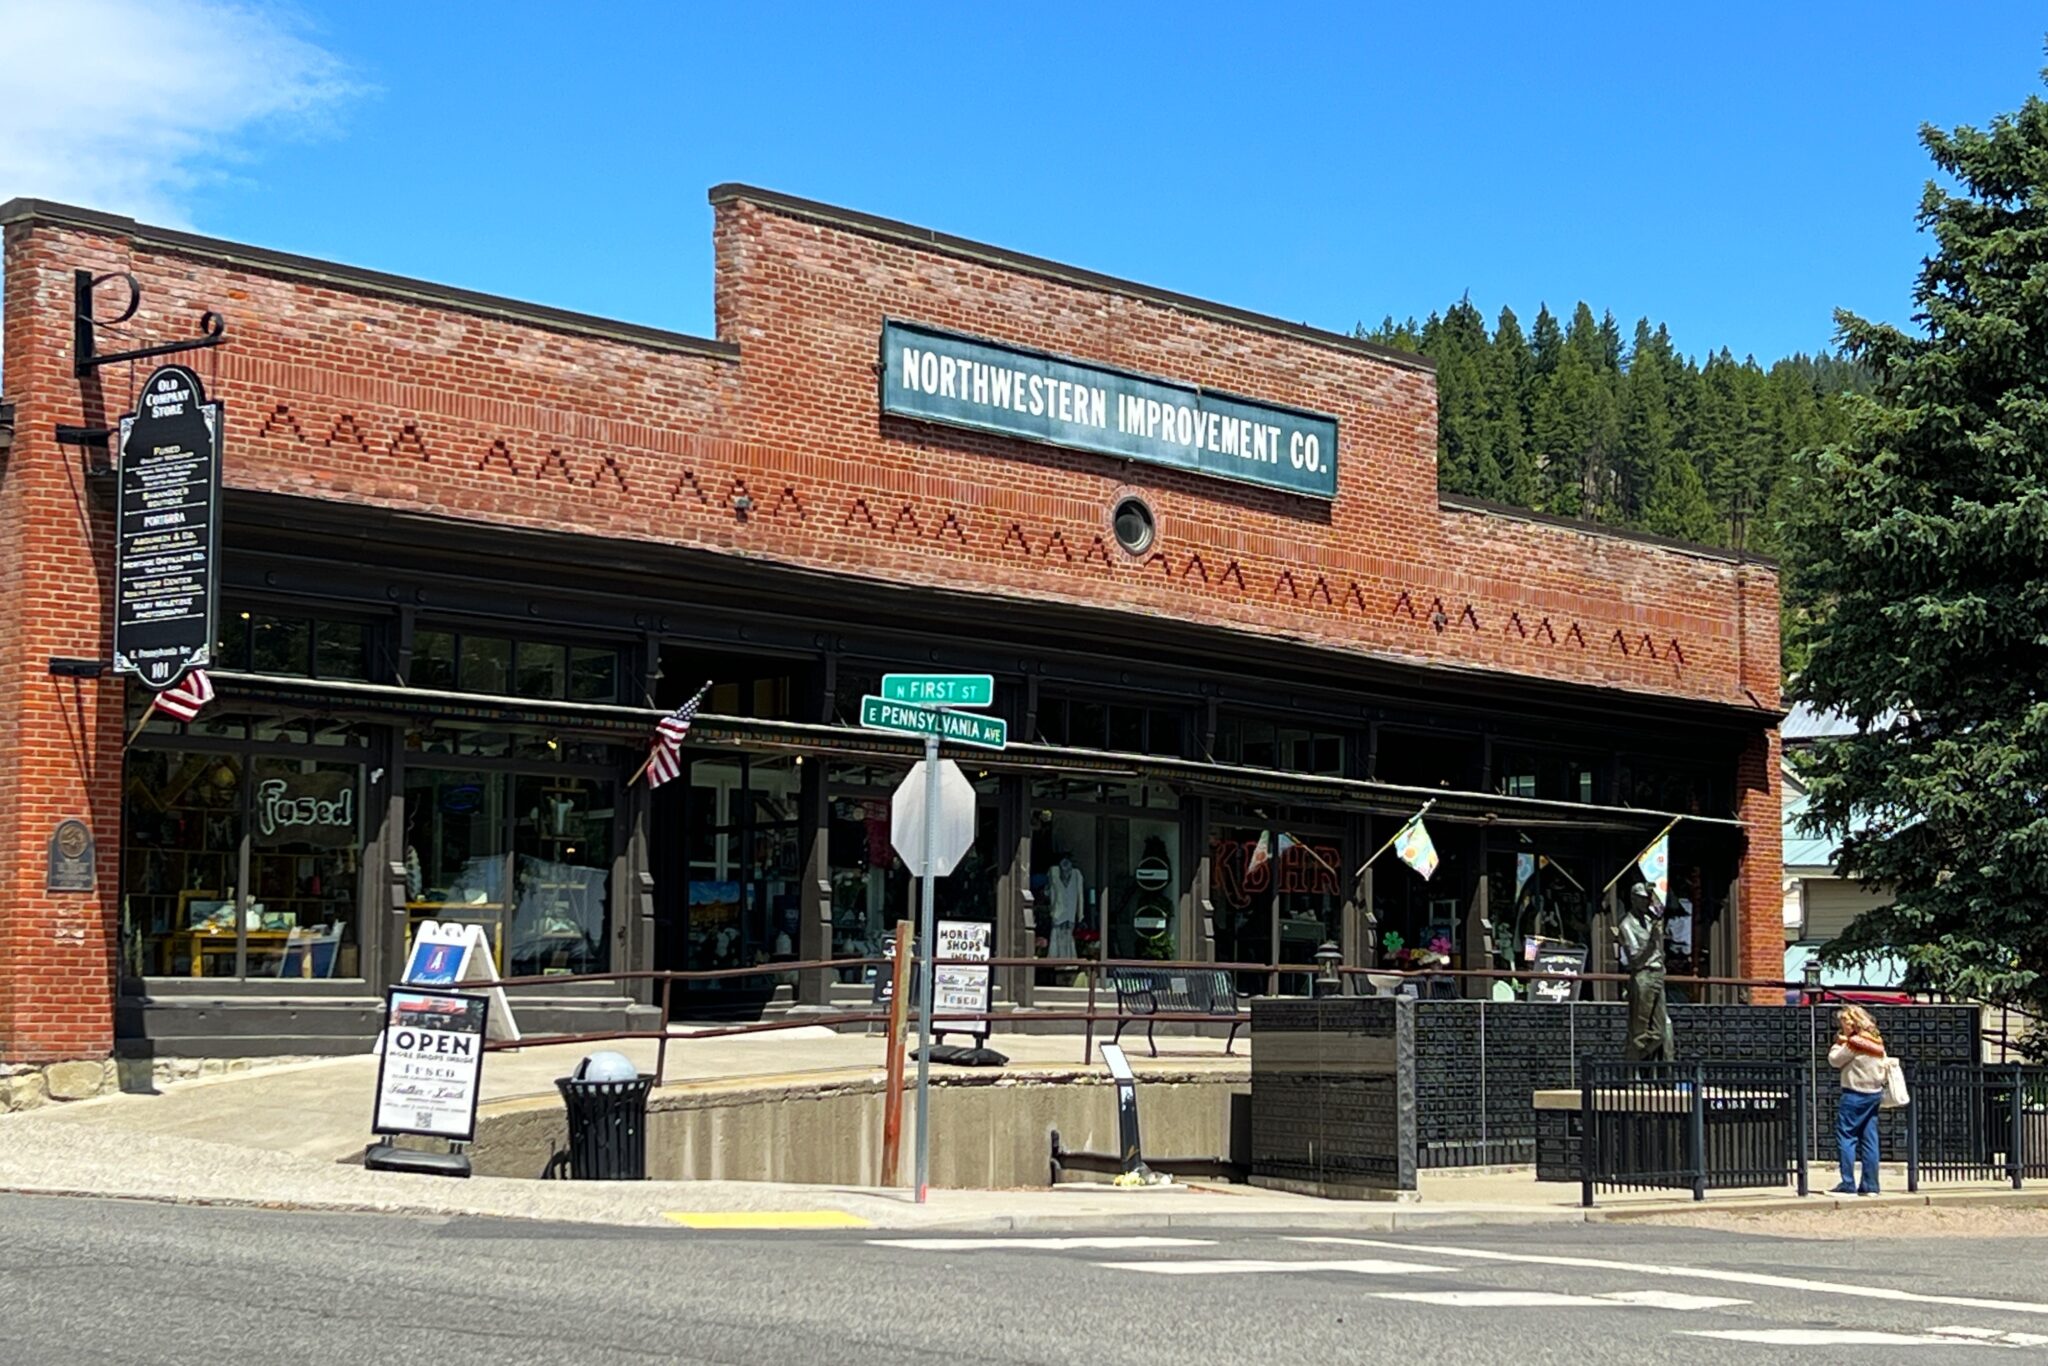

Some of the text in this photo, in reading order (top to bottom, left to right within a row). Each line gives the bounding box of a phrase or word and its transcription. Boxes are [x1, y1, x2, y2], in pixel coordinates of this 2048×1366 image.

[157, 379, 178, 392] OLD
[145, 389, 190, 407] COMPANY
[151, 403, 184, 418] STORE
[902, 347, 1327, 473] NORTHWESTERN IMPROVEMENT CO.
[151, 661, 169, 679] 101
[897, 681, 977, 699] N FIRST ST
[869, 705, 1001, 743] E PENNSYLVANIA AVE
[940, 930, 968, 939] MORE
[946, 940, 981, 951] SHOPS
[396, 1031, 472, 1056] OPEN
